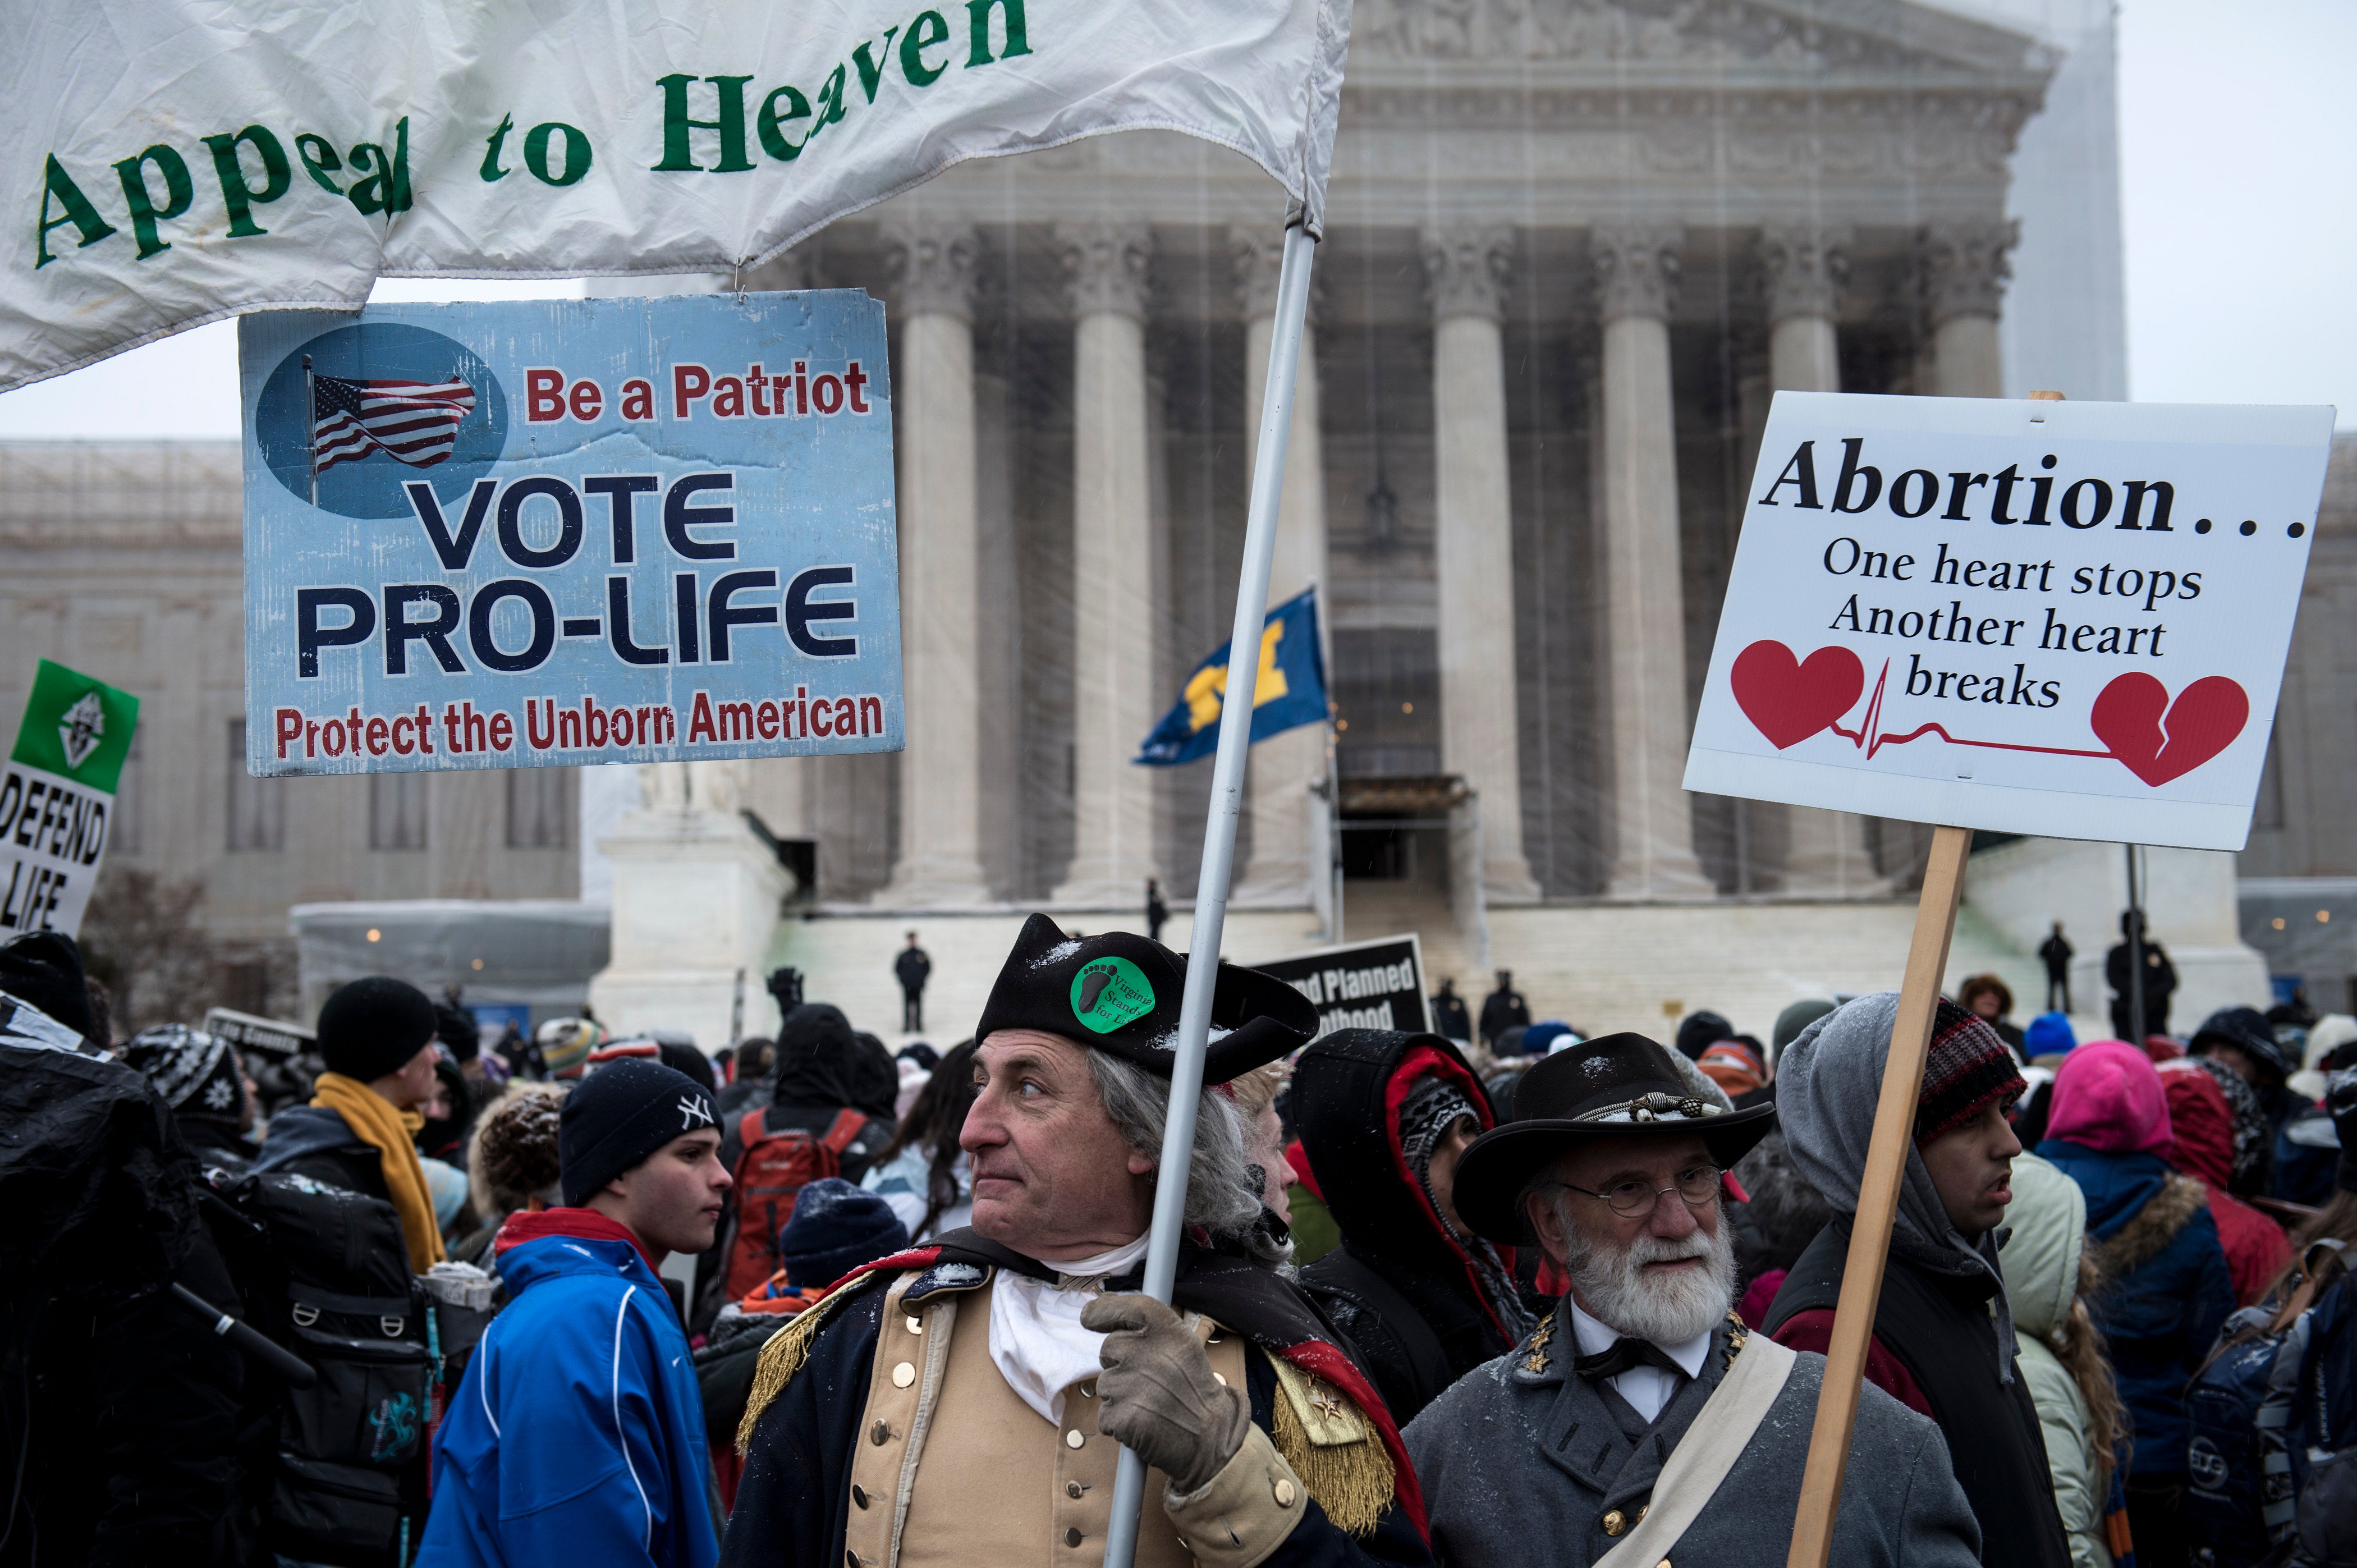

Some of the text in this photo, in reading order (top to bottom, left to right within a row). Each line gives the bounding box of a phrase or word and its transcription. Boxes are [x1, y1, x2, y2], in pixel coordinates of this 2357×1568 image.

[35, 0, 1033, 269] Appeal to Heaven
[528, 361, 869, 421] Be a Patriot
[405, 473, 736, 570] VOTE
[1823, 537, 2203, 611] One heart stops
[297, 567, 857, 678] PRO-LIFE
[1829, 593, 2167, 657] Another heart
[1905, 654, 2061, 708] breaks
[276, 687, 882, 759] Protect the Unborn American
[0, 772, 104, 867] DEFEND
[0, 860, 67, 930] LIFE
[1095, 1005, 1112, 1019] for
[1104, 991, 1142, 1015] Stands
[1115, 974, 1153, 1006] Virginia
[1322, 956, 1416, 1003] Planned
